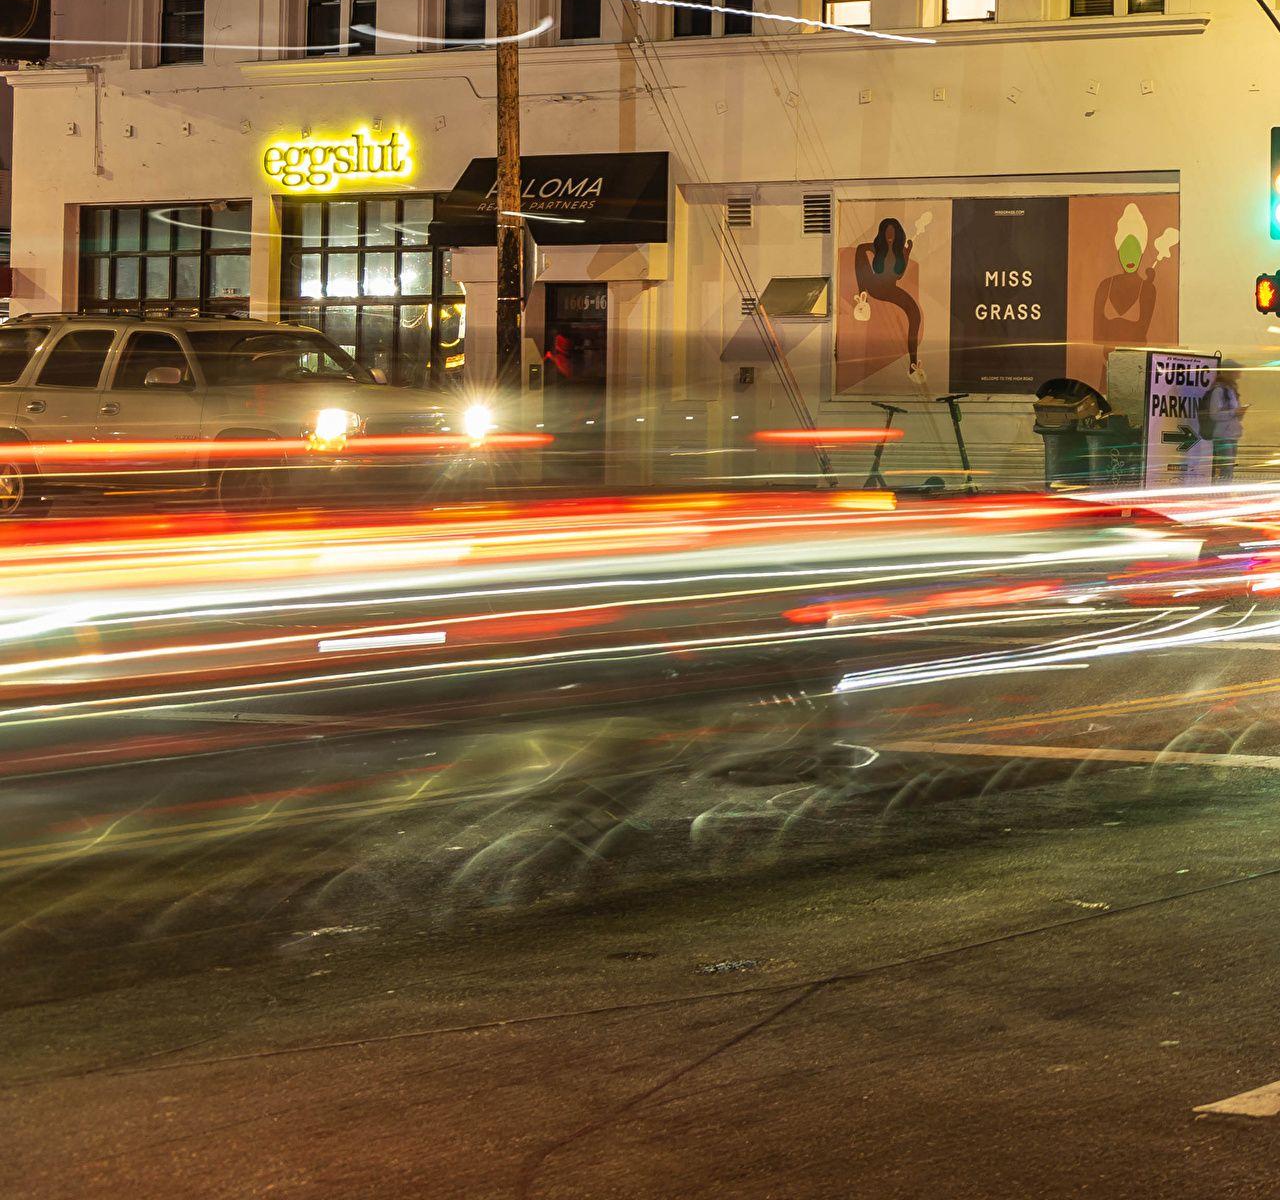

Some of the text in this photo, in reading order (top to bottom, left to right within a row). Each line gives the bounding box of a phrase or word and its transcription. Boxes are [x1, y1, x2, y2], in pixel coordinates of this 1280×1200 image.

[263, 132, 406, 187] eggslut
[529, 200, 597, 211] PARTNERS
[984, 270, 1033, 287] MISS
[975, 303, 1041, 321] GRASS
[1155, 362, 1211, 388] PUBLIC
[1152, 394, 1201, 419] PARKIN
